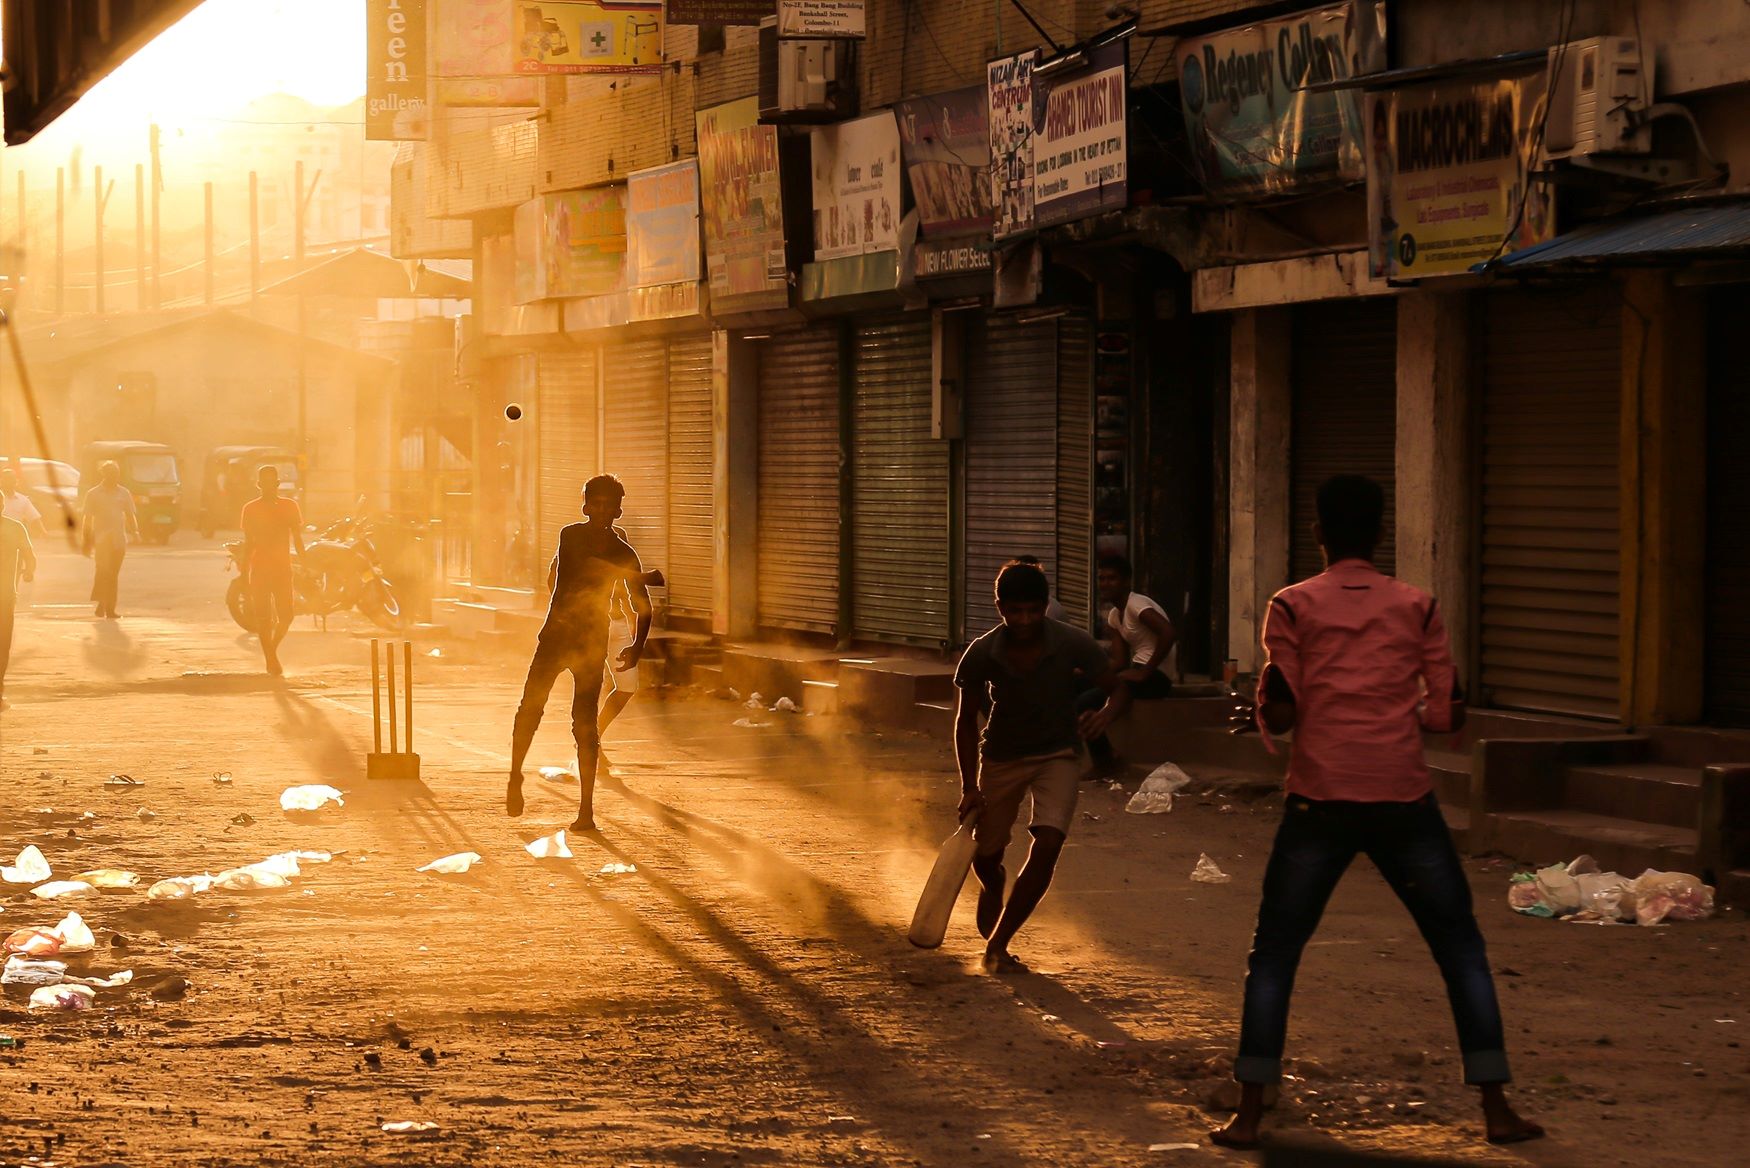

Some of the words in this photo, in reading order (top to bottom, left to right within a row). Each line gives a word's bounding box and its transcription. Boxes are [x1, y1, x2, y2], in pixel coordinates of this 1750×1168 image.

[1203, 43, 1274, 116] Regency
[369, 93, 425, 117] gallery
[992, 84, 1031, 110] CENTRUM
[1076, 76, 1107, 133] TOURIST
[1108, 72, 1123, 123] INN
[924, 251, 941, 273] NEW
[941, 248, 968, 271] FLOWER
